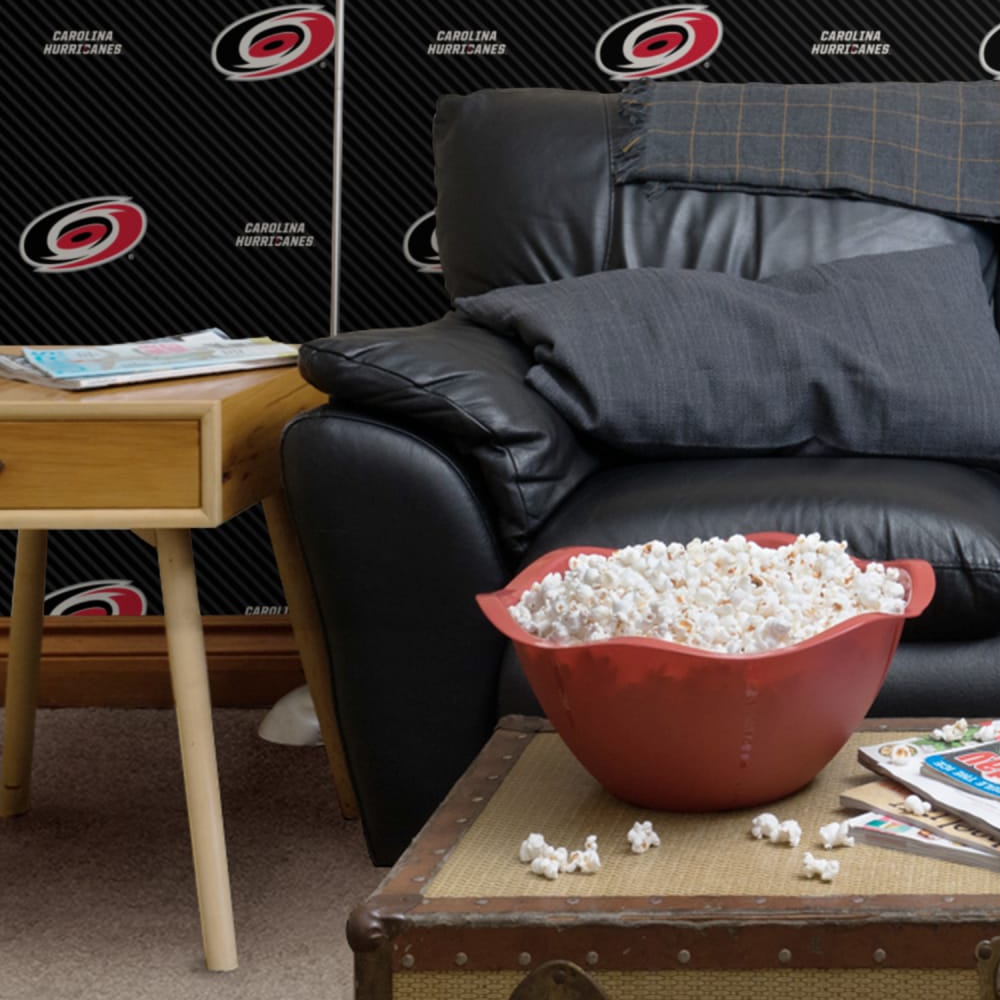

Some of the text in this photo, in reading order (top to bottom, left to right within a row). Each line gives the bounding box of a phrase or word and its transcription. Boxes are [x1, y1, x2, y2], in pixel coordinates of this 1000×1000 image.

[52, 30, 113, 42] CAROLINA
[436, 30, 497, 42] CAROLINA
[820, 30, 881, 42] CAROLINA
[43, 43, 123, 56] HURRICANES
[427, 43, 507, 56] HURRICANES
[811, 43, 891, 56] HURRICANES
[244, 221, 305, 233] CAROLINA
[235, 234, 315, 247] HURRICANES
[244, 605, 289, 615] CAROLI
